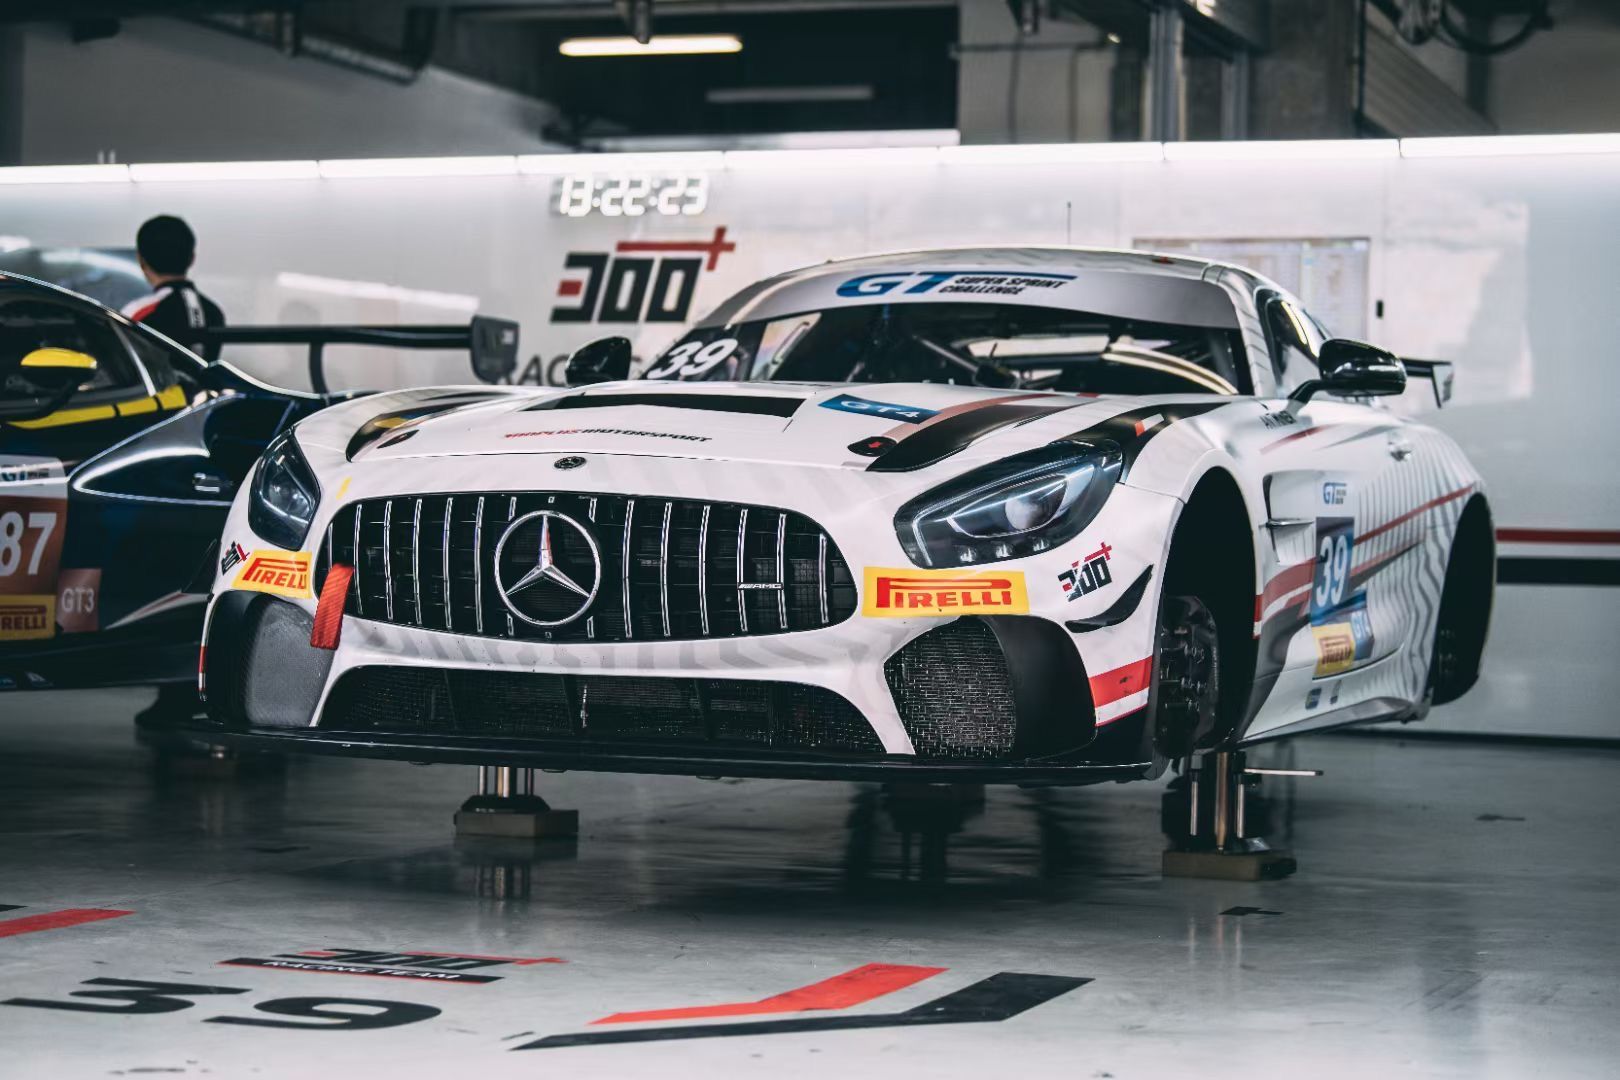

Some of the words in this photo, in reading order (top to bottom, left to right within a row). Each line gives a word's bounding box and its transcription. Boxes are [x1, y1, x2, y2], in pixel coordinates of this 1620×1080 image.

[559, 174, 709, 217] 13:22:23
[836, 271, 958, 298] GT
[953, 276, 1009, 285] SUPER
[1006, 277, 1068, 289] SPRINT
[938, 285, 1027, 295] CHALLENGE
[646, 338, 739, 379] 39
[840, 400, 920, 418] GT4
[242, 557, 308, 590] PIRELLI
[1316, 534, 1348, 608] 39
[62, 587, 95, 613] GT3
[875, 576, 1013, 609] PIRELLI
[0, 604, 47, 630] RELLI
[262, 959, 370, 974] RACING
[376, 968, 461, 980] TEAM
